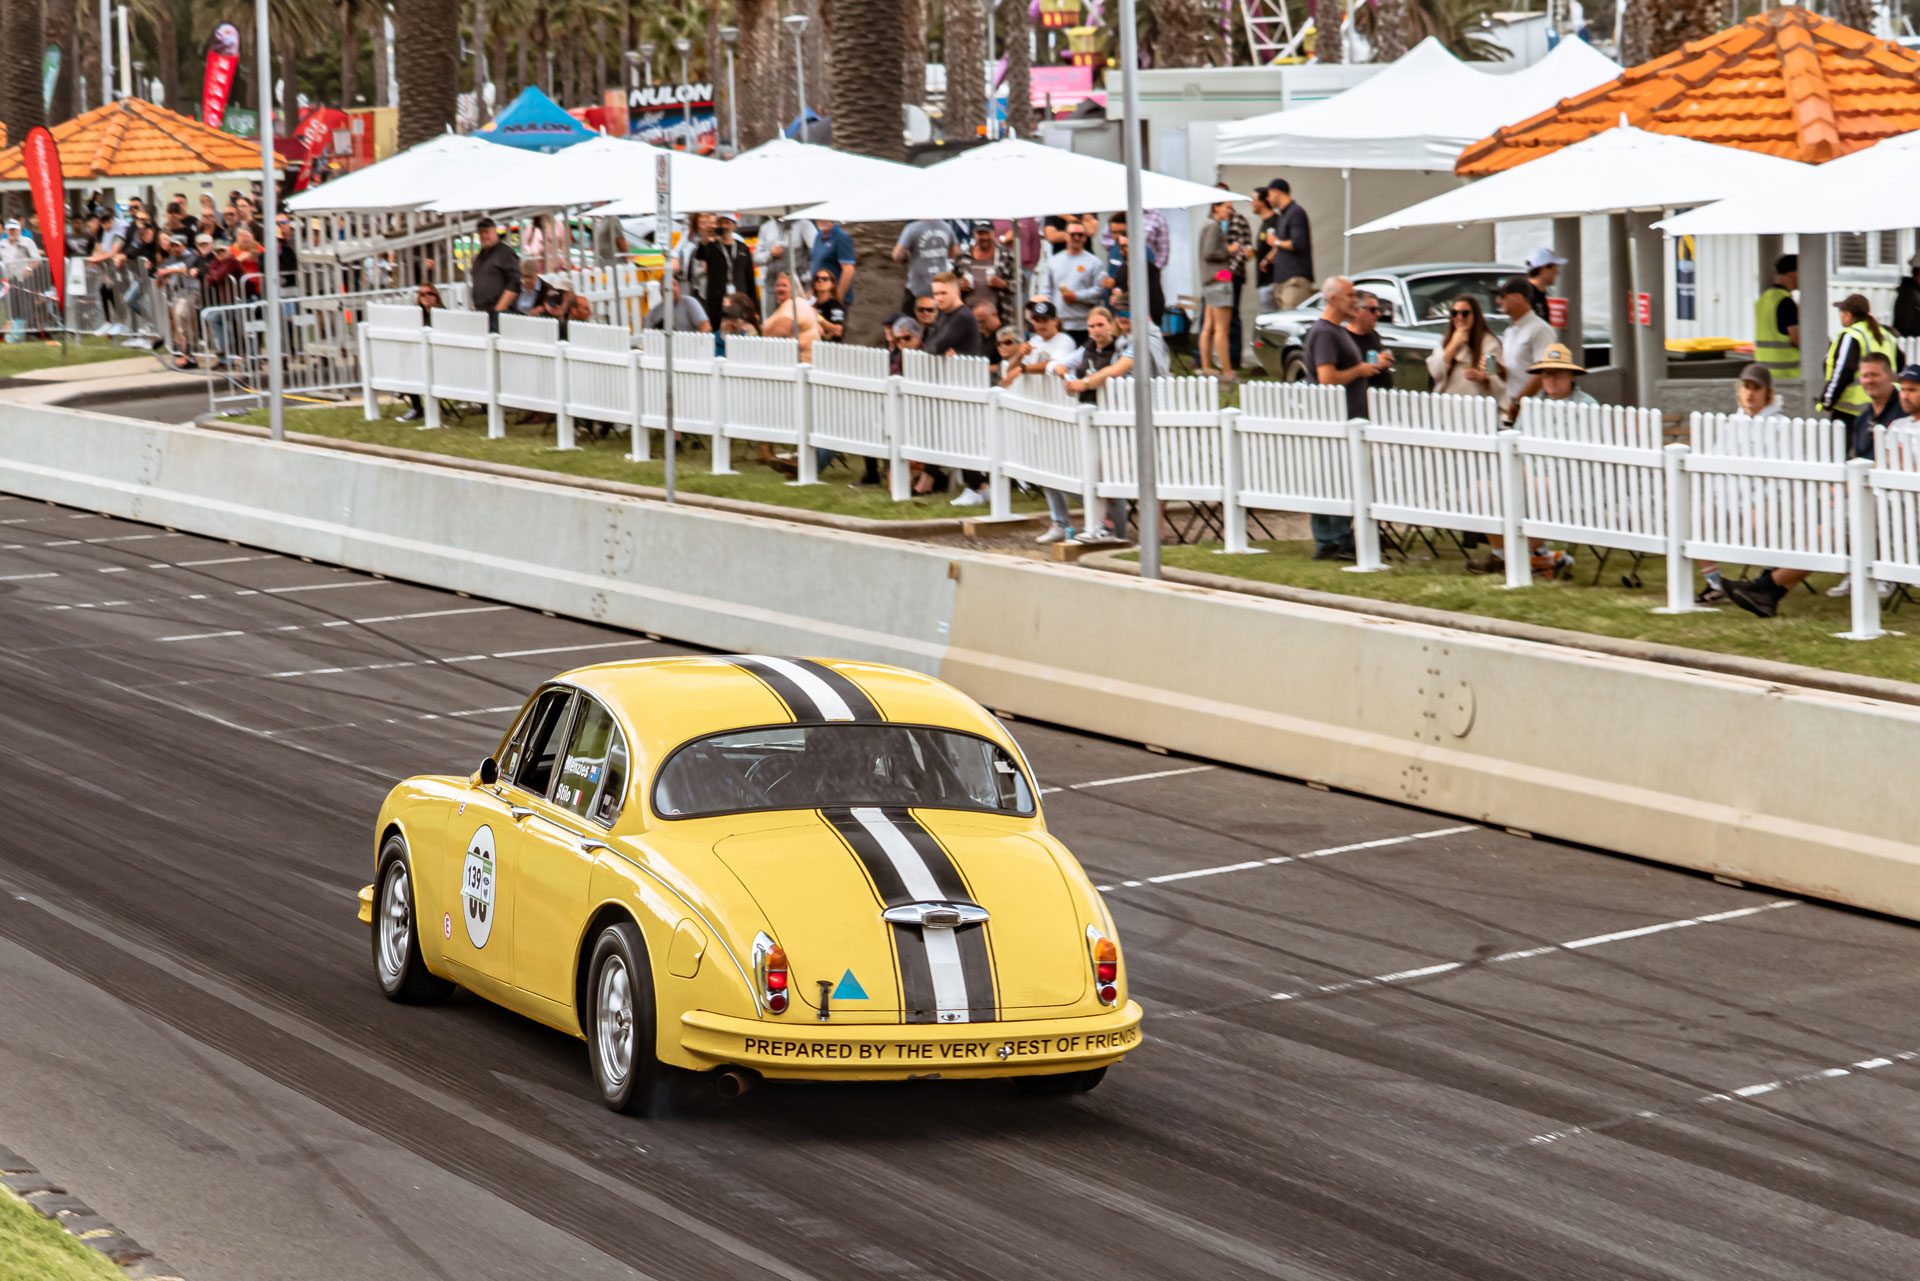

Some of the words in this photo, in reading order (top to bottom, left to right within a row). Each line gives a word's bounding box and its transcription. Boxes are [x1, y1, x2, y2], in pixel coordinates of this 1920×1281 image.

[629, 83, 713, 107] NULON
[468, 865, 482, 890] 139
[745, 1038, 852, 1059] PREPARED
[859, 1044, 887, 1059] BY
[895, 1044, 933, 1059] THE
[939, 1042, 990, 1059] VERY
[1004, 1039, 1052, 1056] BEST
[1056, 1036, 1080, 1053] OF
[1085, 1027, 1137, 1050] FRIENDS
